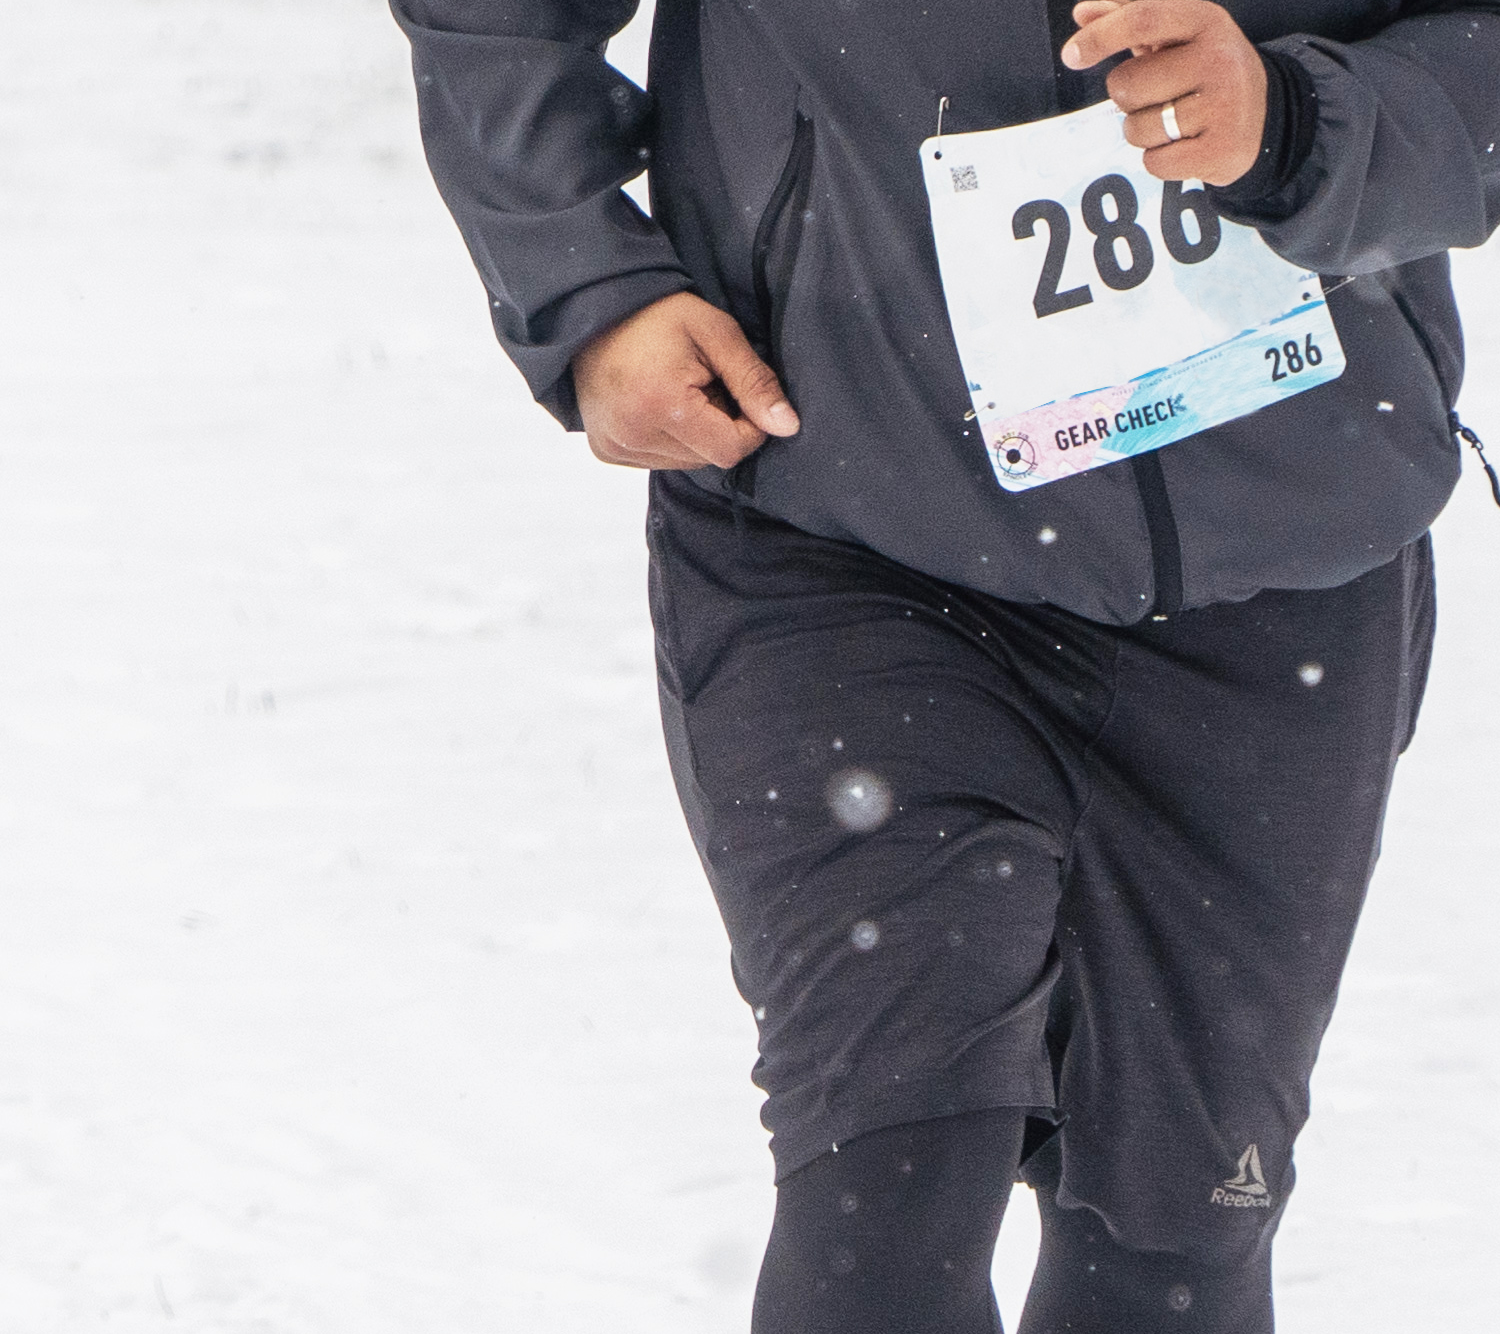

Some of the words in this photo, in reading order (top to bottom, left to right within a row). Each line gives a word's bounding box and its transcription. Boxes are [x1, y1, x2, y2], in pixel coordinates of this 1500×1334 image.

[1011, 173, 1221, 319] 286
[1264, 333, 1323, 383] 286
[1055, 418, 1112, 452] GEAR
[1114, 394, 1186, 435] CHECK
